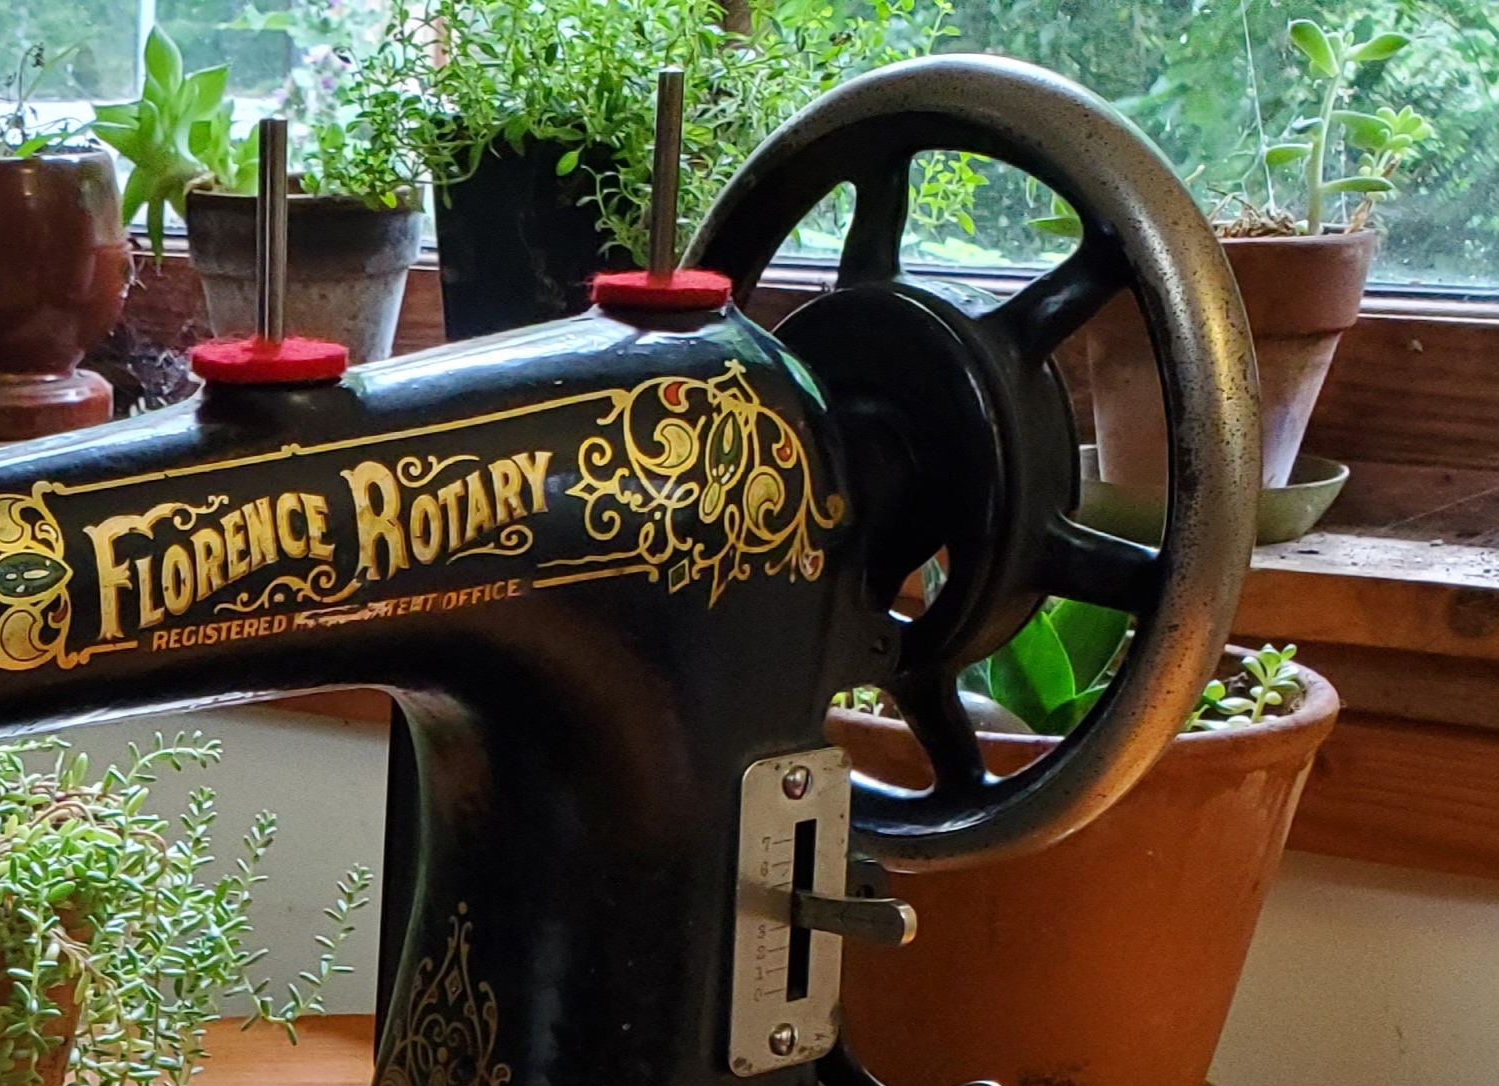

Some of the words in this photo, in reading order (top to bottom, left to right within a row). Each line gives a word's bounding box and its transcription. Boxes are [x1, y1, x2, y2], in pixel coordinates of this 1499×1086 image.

[84, 493, 336, 640] FLORENCE
[339, 451, 553, 582] ROTARY
[152, 615, 287, 651] REGISTERED
[366, 593, 439, 620] ATENT
[442, 578, 522, 610] OFFICE
